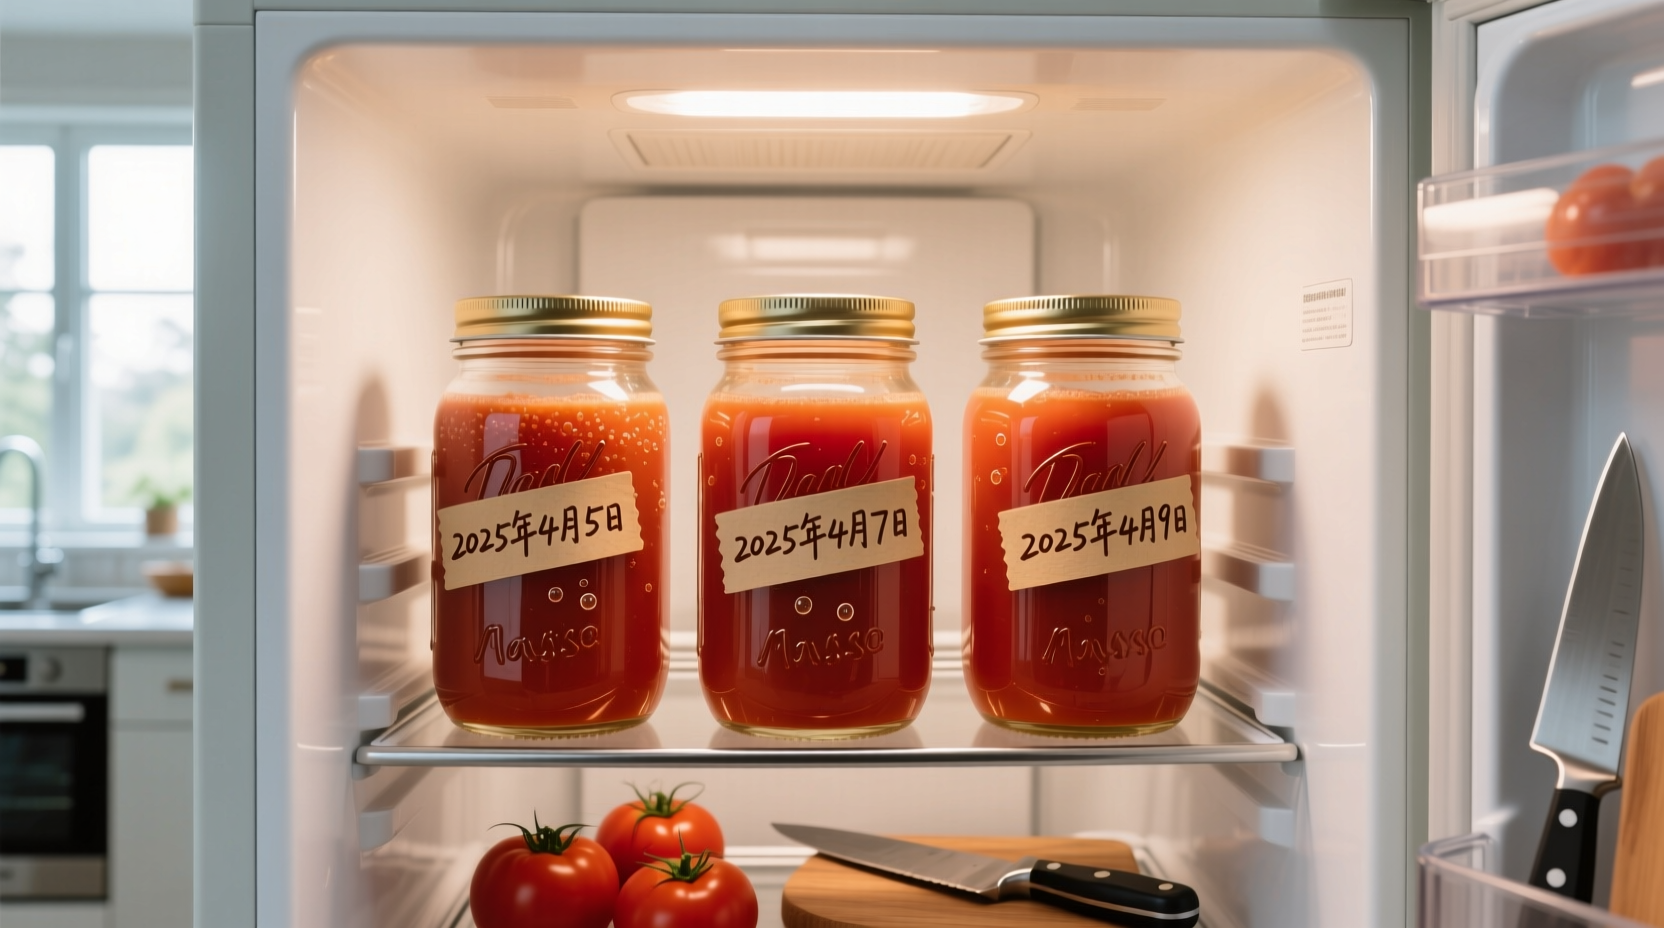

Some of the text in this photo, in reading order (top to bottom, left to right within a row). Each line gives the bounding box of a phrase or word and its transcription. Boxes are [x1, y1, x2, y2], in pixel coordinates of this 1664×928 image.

[451, 502, 623, 557] 2025年4月5日
[734, 508, 908, 563] 2025年4月7日
[1020, 503, 1188, 561] 2025年4月9日
